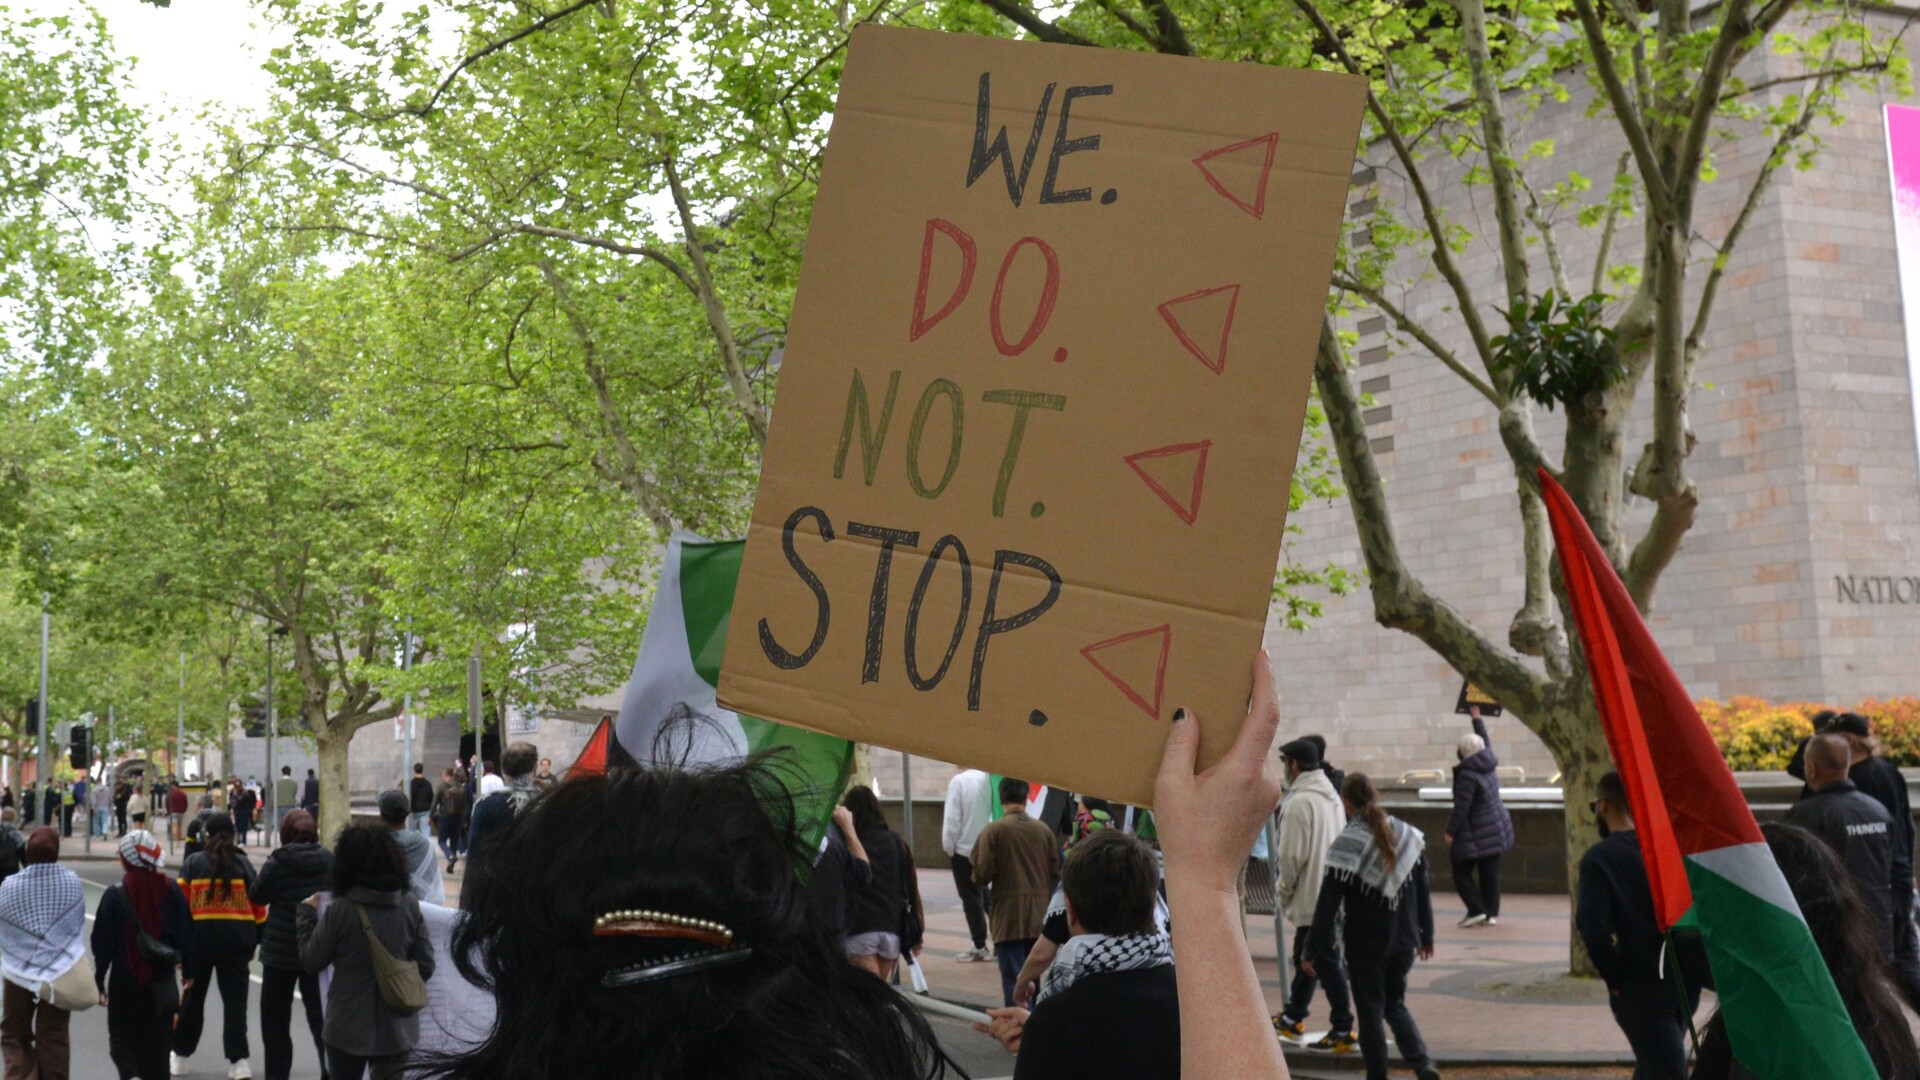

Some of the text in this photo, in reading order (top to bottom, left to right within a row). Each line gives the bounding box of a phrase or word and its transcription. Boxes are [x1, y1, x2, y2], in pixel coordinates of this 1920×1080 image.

[966, 71, 1118, 208] WE.
[910, 217, 1069, 364] DO.
[833, 367, 1067, 519] NOT.
[758, 505, 1063, 727] STOP.
[1846, 822, 1887, 836] THUNDER
